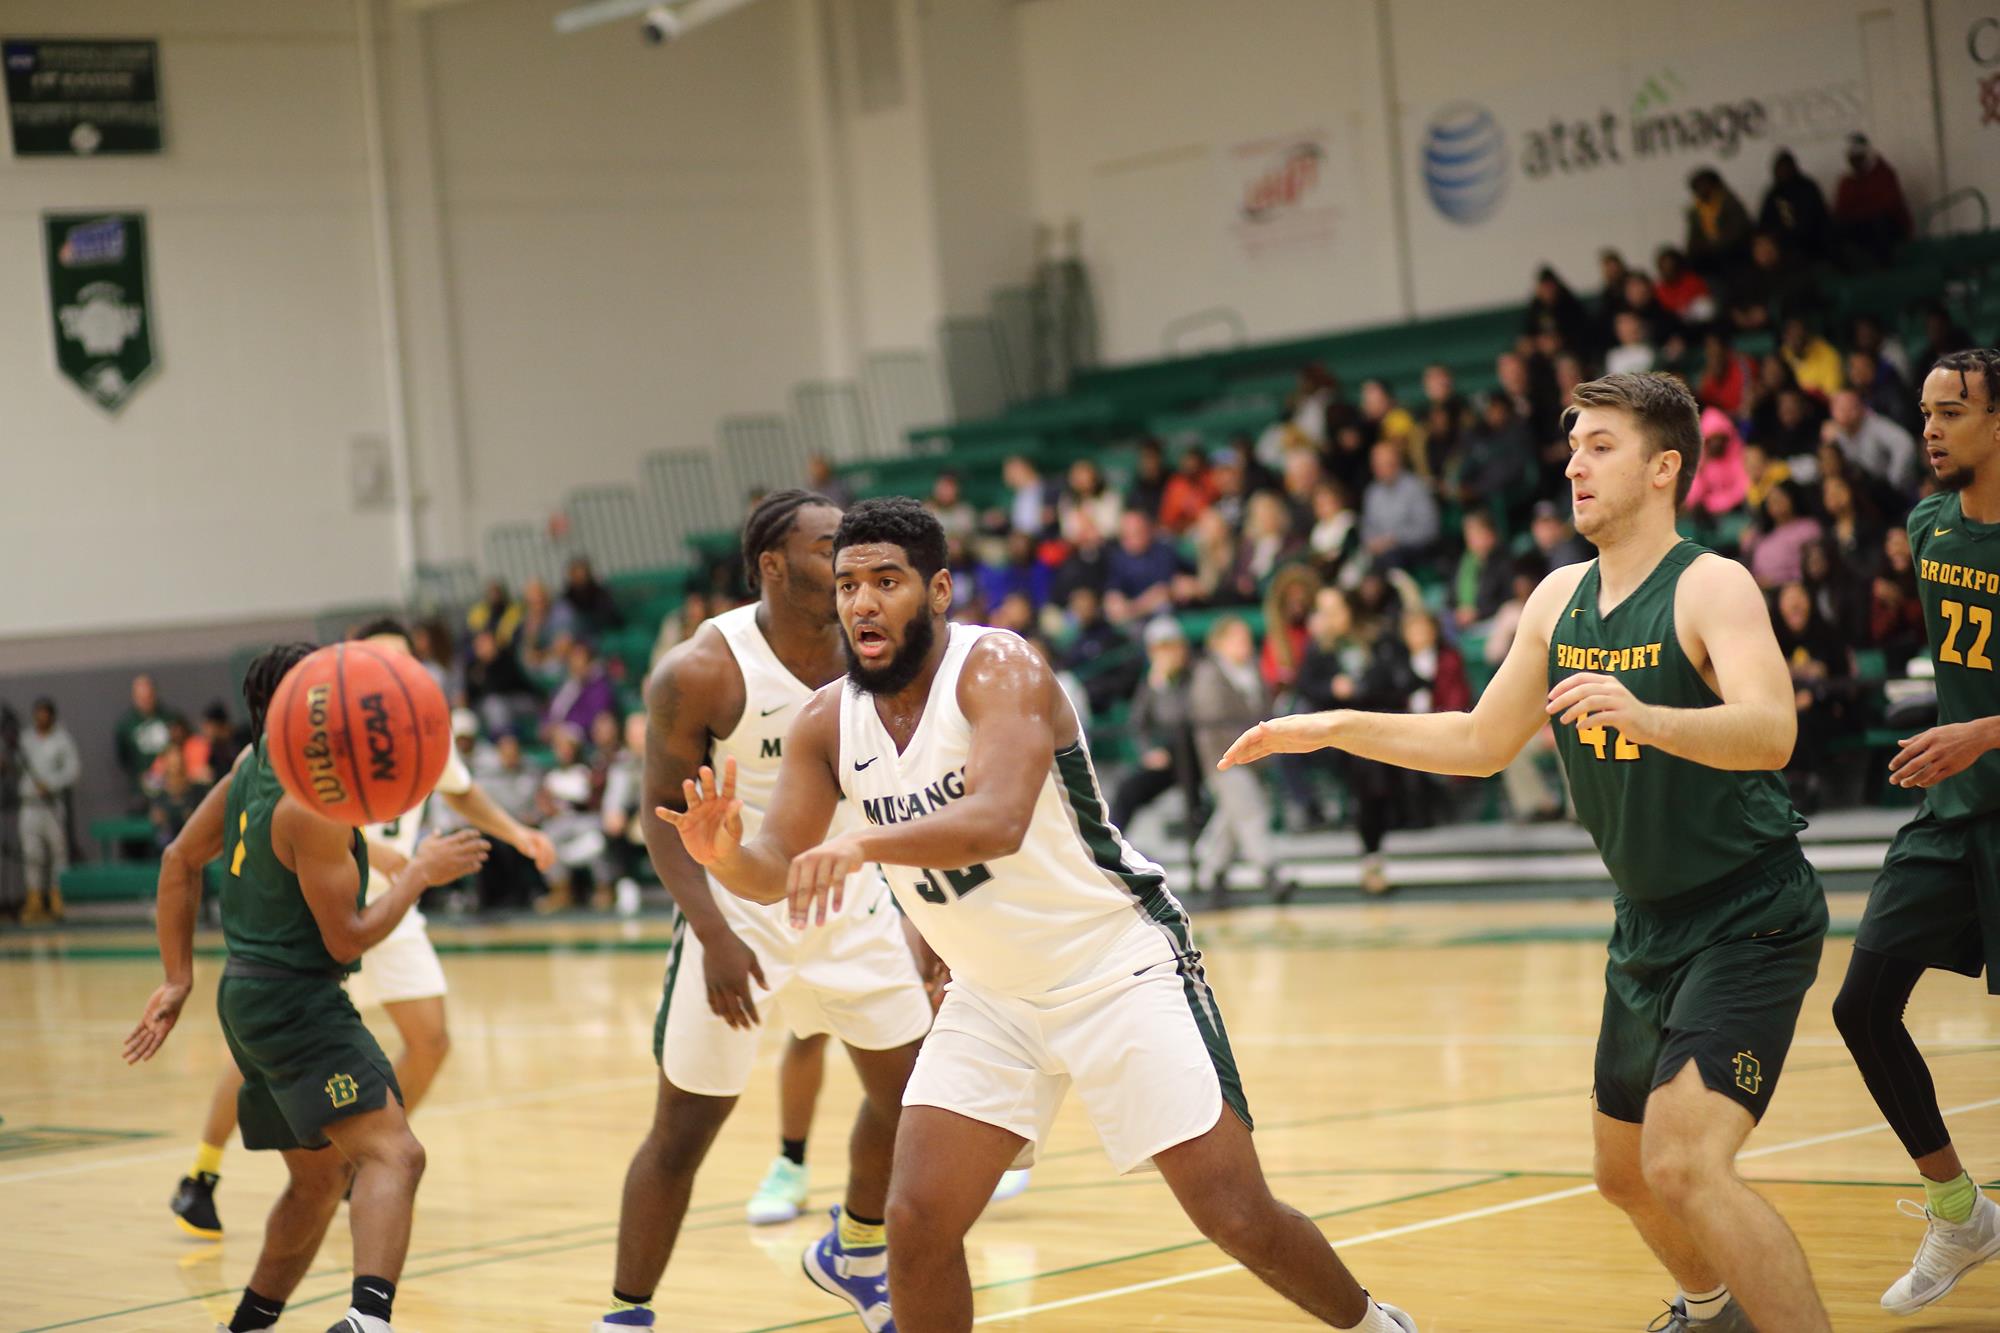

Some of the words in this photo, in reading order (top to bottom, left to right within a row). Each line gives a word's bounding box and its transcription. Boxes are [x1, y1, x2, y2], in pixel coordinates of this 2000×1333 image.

[1920, 559, 2000, 595] BROCKPO
[1939, 599, 1993, 672] 22
[303, 682, 347, 804] Wilson
[360, 692, 397, 782] NCAA
[760, 737, 784, 758] M
[862, 765, 967, 826] MUSANG
